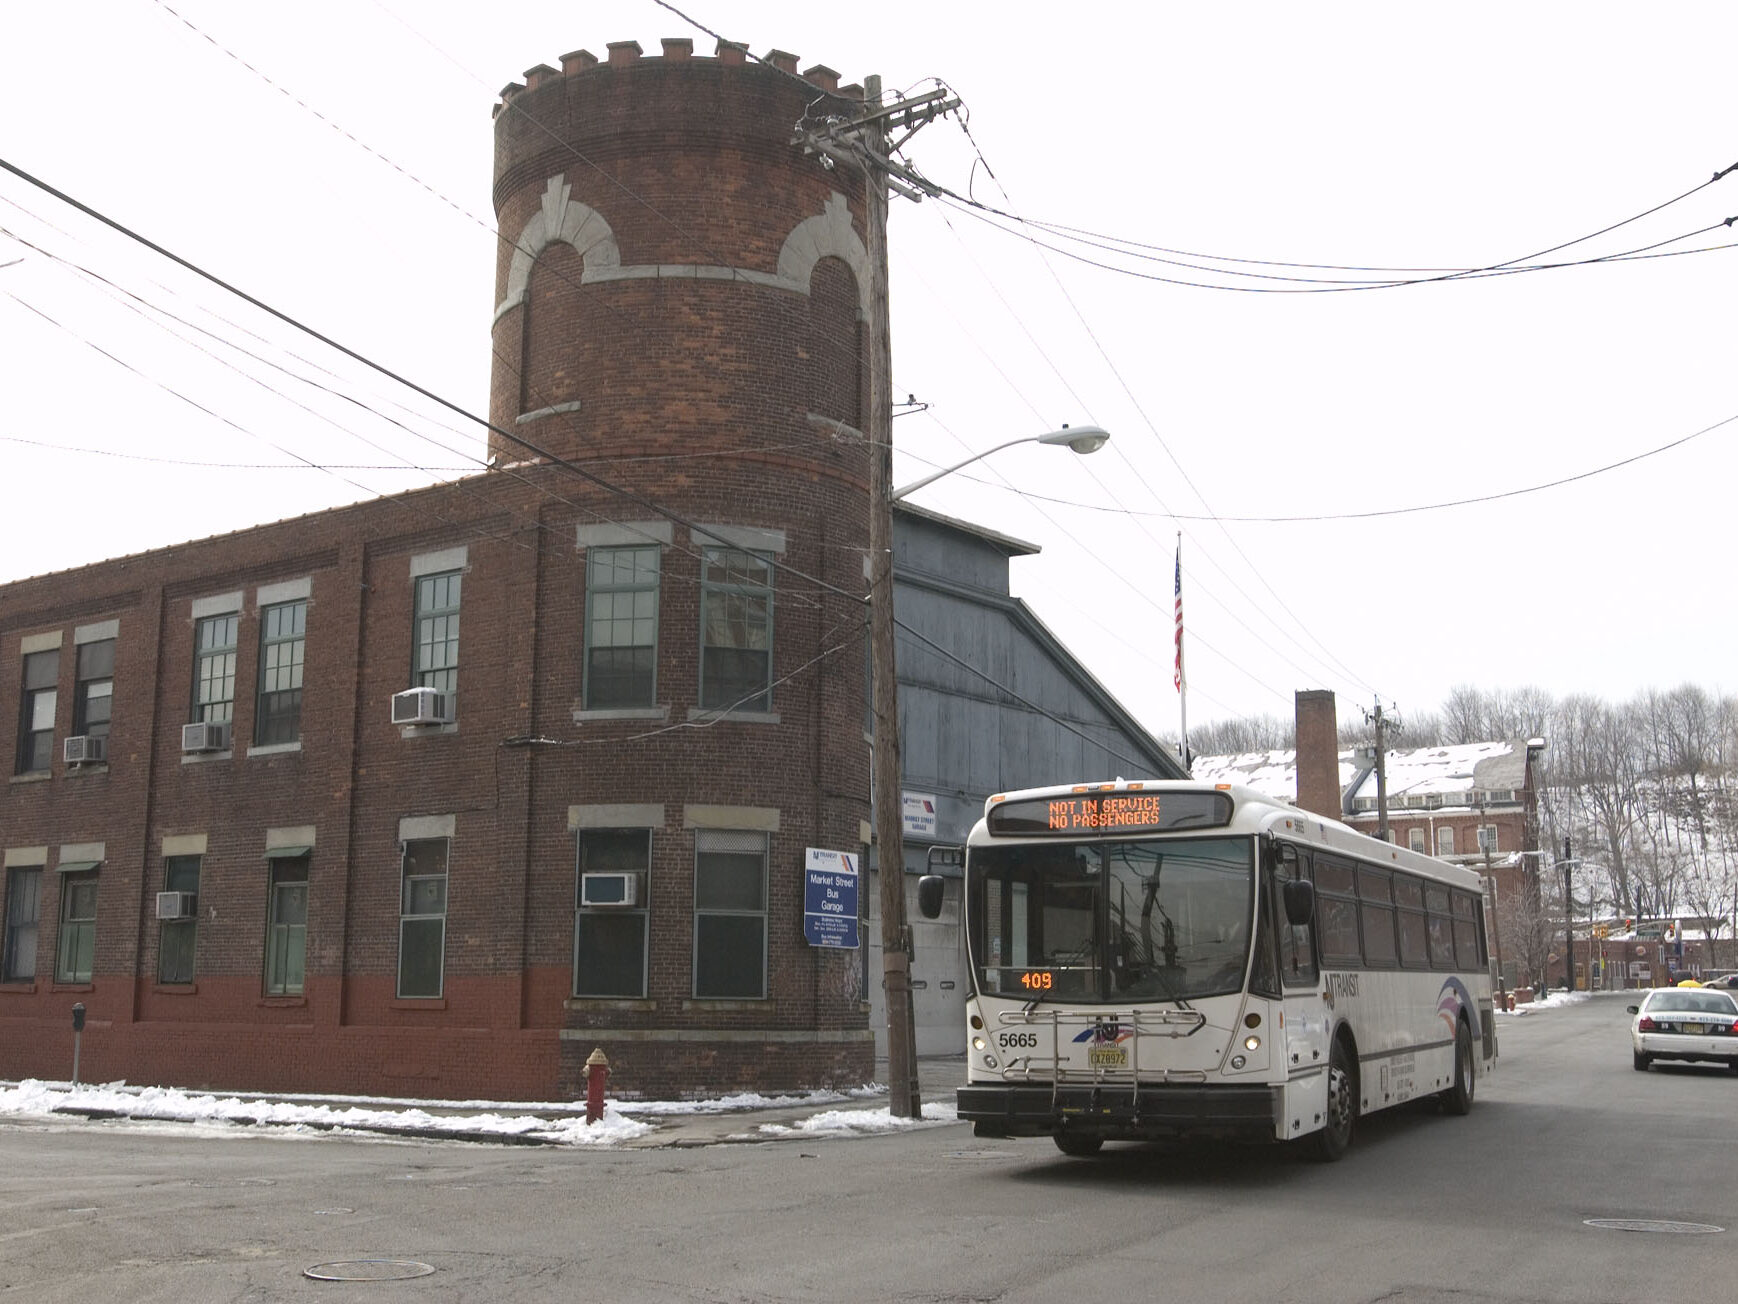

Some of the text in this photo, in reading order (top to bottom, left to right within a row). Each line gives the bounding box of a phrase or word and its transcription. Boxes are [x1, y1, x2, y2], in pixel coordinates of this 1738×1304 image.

[1050, 797, 1160, 815] NOT IN SERVICE
[1050, 811, 1160, 828] NO PASSENGERS
[810, 874, 854, 888] Market Street
[826, 889, 839, 899] Bus
[821, 900, 844, 912] Garage
[1021, 972, 1052, 989] 409
[999, 1033, 1037, 1048] 5665
